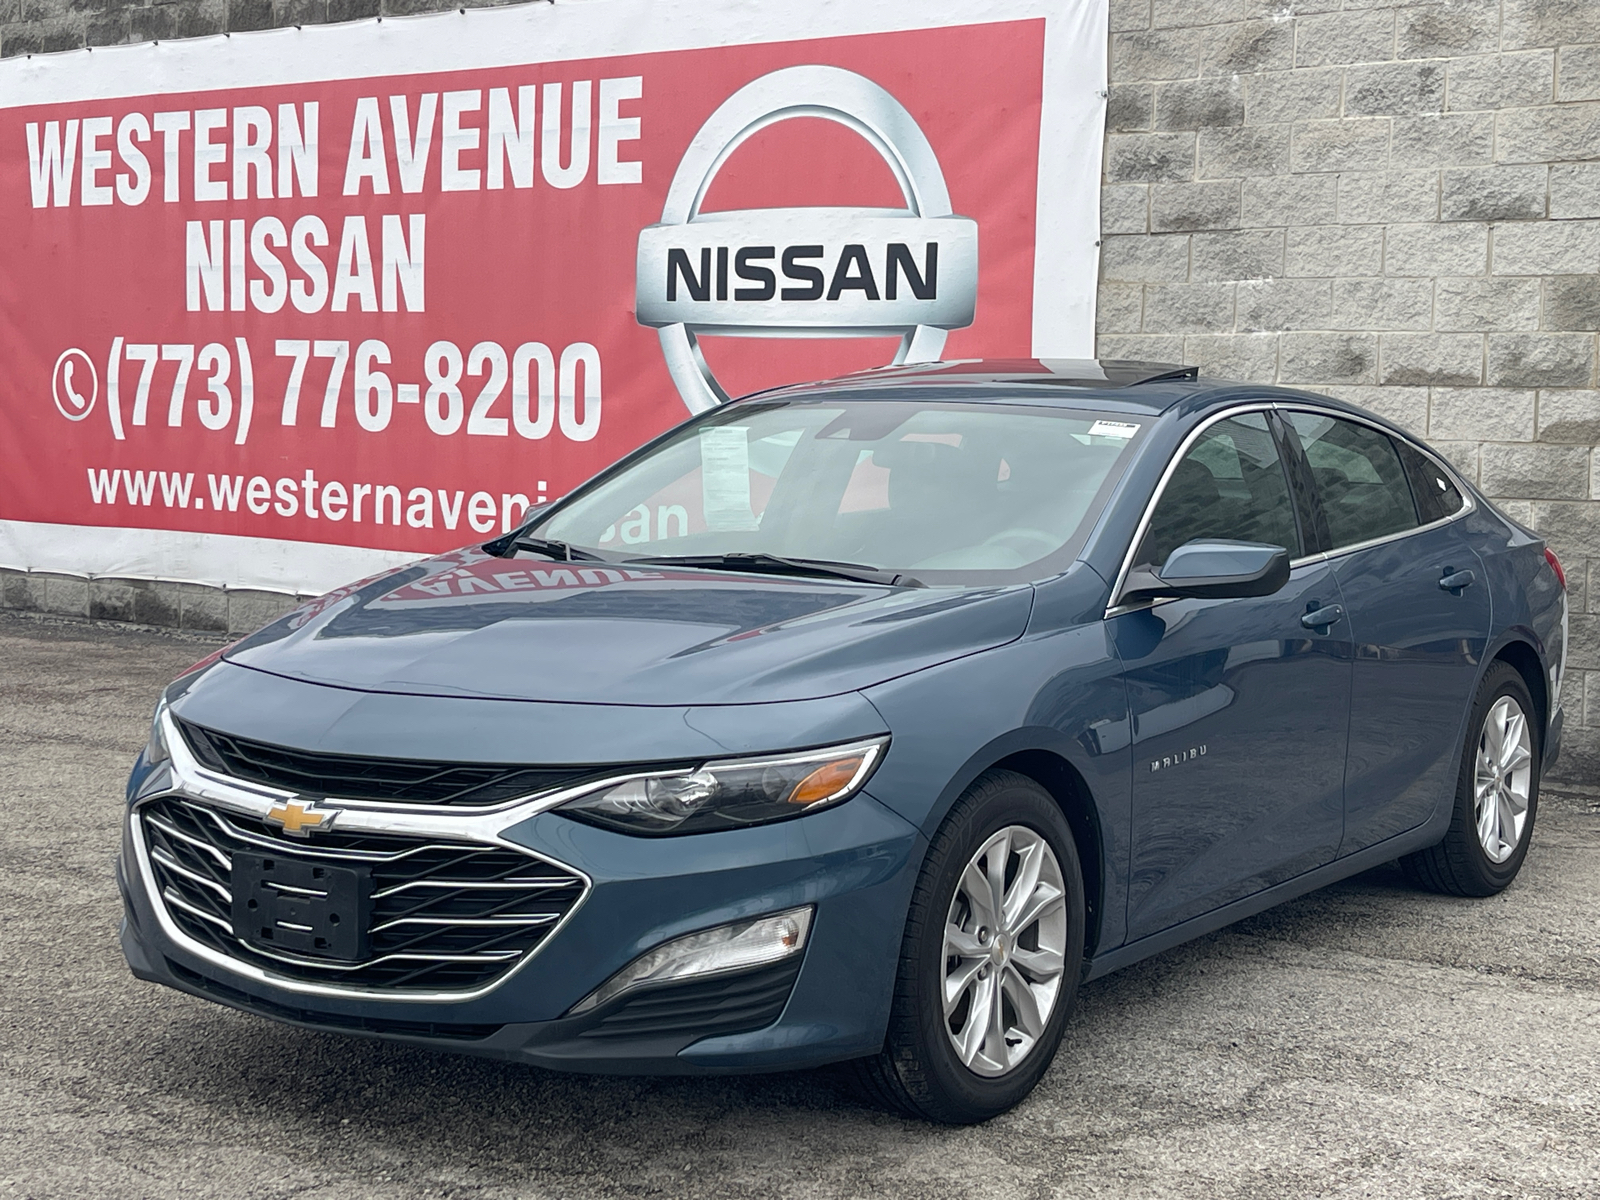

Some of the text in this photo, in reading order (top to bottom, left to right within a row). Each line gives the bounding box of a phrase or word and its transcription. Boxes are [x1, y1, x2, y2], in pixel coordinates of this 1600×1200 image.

[25, 75, 643, 209] WESTERN AVENUE
[186, 213, 426, 314] NISSAN
[666, 242, 939, 302] NISSAN
[107, 337, 601, 445] (773) 776-8200
[1150, 744, 1207, 773] MALIBU
